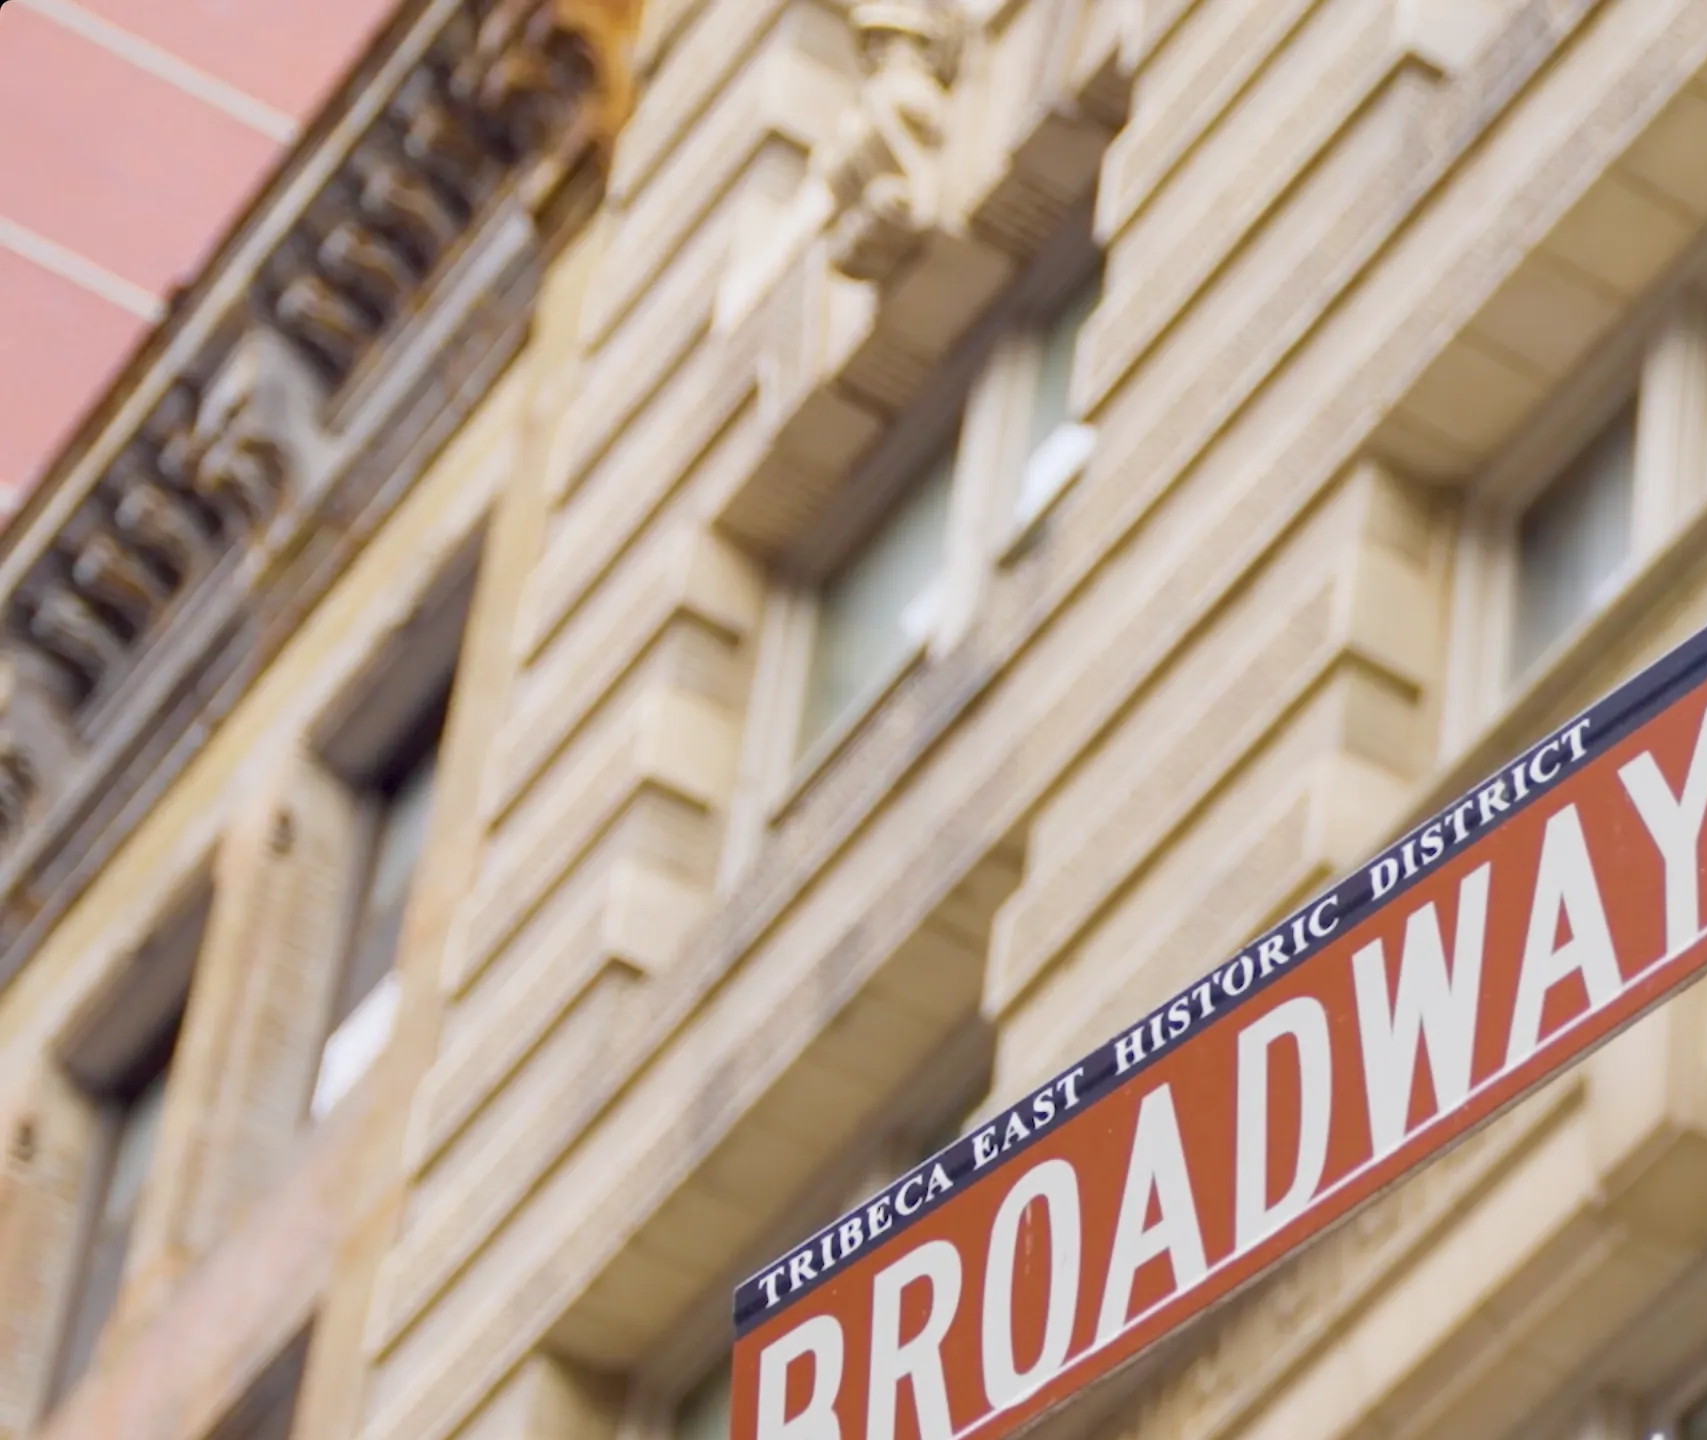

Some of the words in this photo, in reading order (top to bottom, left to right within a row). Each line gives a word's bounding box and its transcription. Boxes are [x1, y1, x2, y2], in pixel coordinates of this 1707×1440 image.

[758, 1162, 954, 1309] TRIBECA
[971, 1067, 1085, 1171] EAST
[1113, 895, 1340, 1076] HISTORIC
[1369, 719, 1591, 900] DISTRICT
